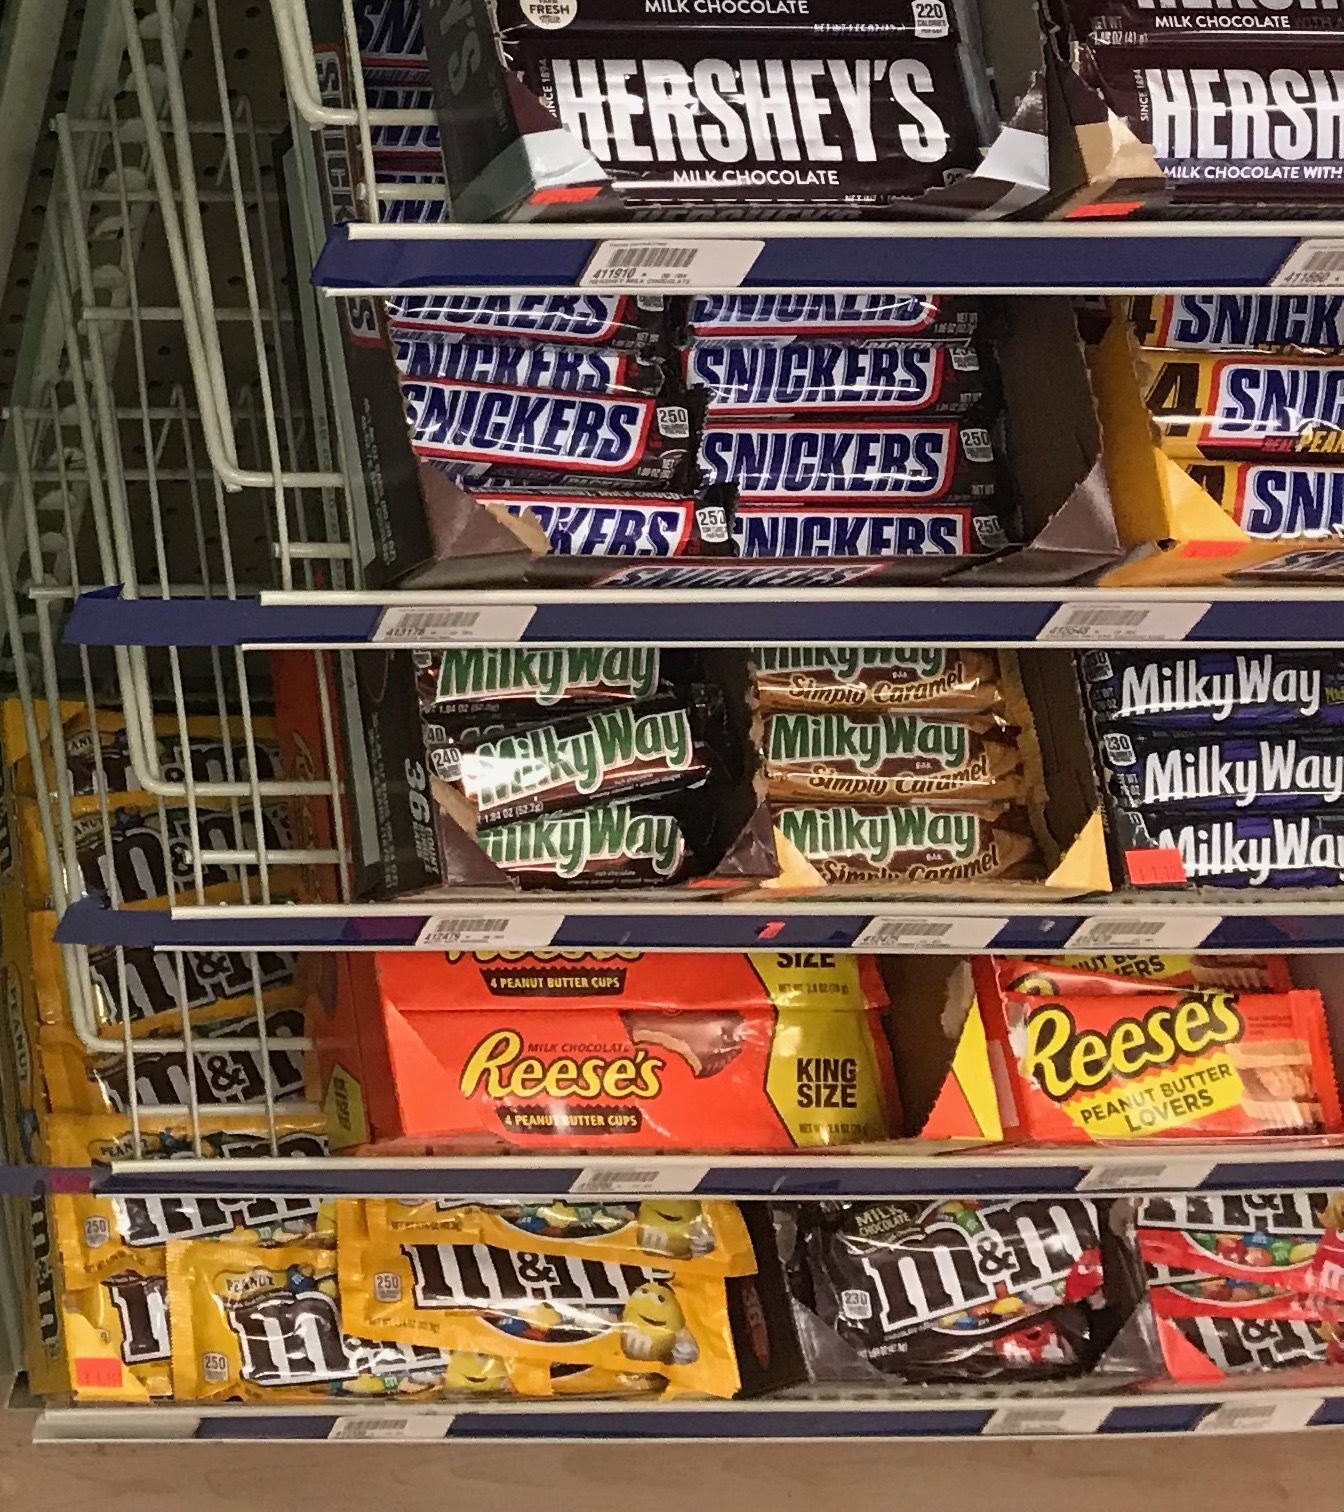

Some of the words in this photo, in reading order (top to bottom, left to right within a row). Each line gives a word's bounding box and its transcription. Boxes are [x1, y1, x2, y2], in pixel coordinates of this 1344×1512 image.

[528, 2, 570, 16] FRESH
[915, 3, 944, 19] 220
[551, 57, 949, 164] HERSHEY'S
[672, 169, 718, 186] MILK
[722, 169, 840, 187] CHOCOLATE
[1163, 165, 1200, 179] MILK
[1203, 165, 1300, 180] CHOCOLATE
[1302, 165, 1343, 180] WITH
[695, 344, 930, 403] SNICKERS
[1144, 362, 1203, 438] 4
[659, 409, 687, 425] 250
[702, 431, 944, 493] SNICKERS
[432, 749, 460, 767] 240
[808, 764, 889, 797] Simply
[894, 755, 989, 795] Caramel
[490, 977, 498, 989] 4
[499, 976, 546, 990] PEANUT
[547, 975, 590, 989] BUTTER
[591, 975, 621, 989] CUPS
[1026, 991, 1244, 1100] Reese's
[461, 1030, 665, 1100] Reese's
[796, 1057, 858, 1083] KING
[796, 1084, 858, 1109] SIZE
[1080, 1086, 1157, 1125] PEANUT
[1158, 1063, 1234, 1097] BUTTER
[1123, 1090, 1215, 1133] LOVERS
[204, 1356, 228, 1372] 250
